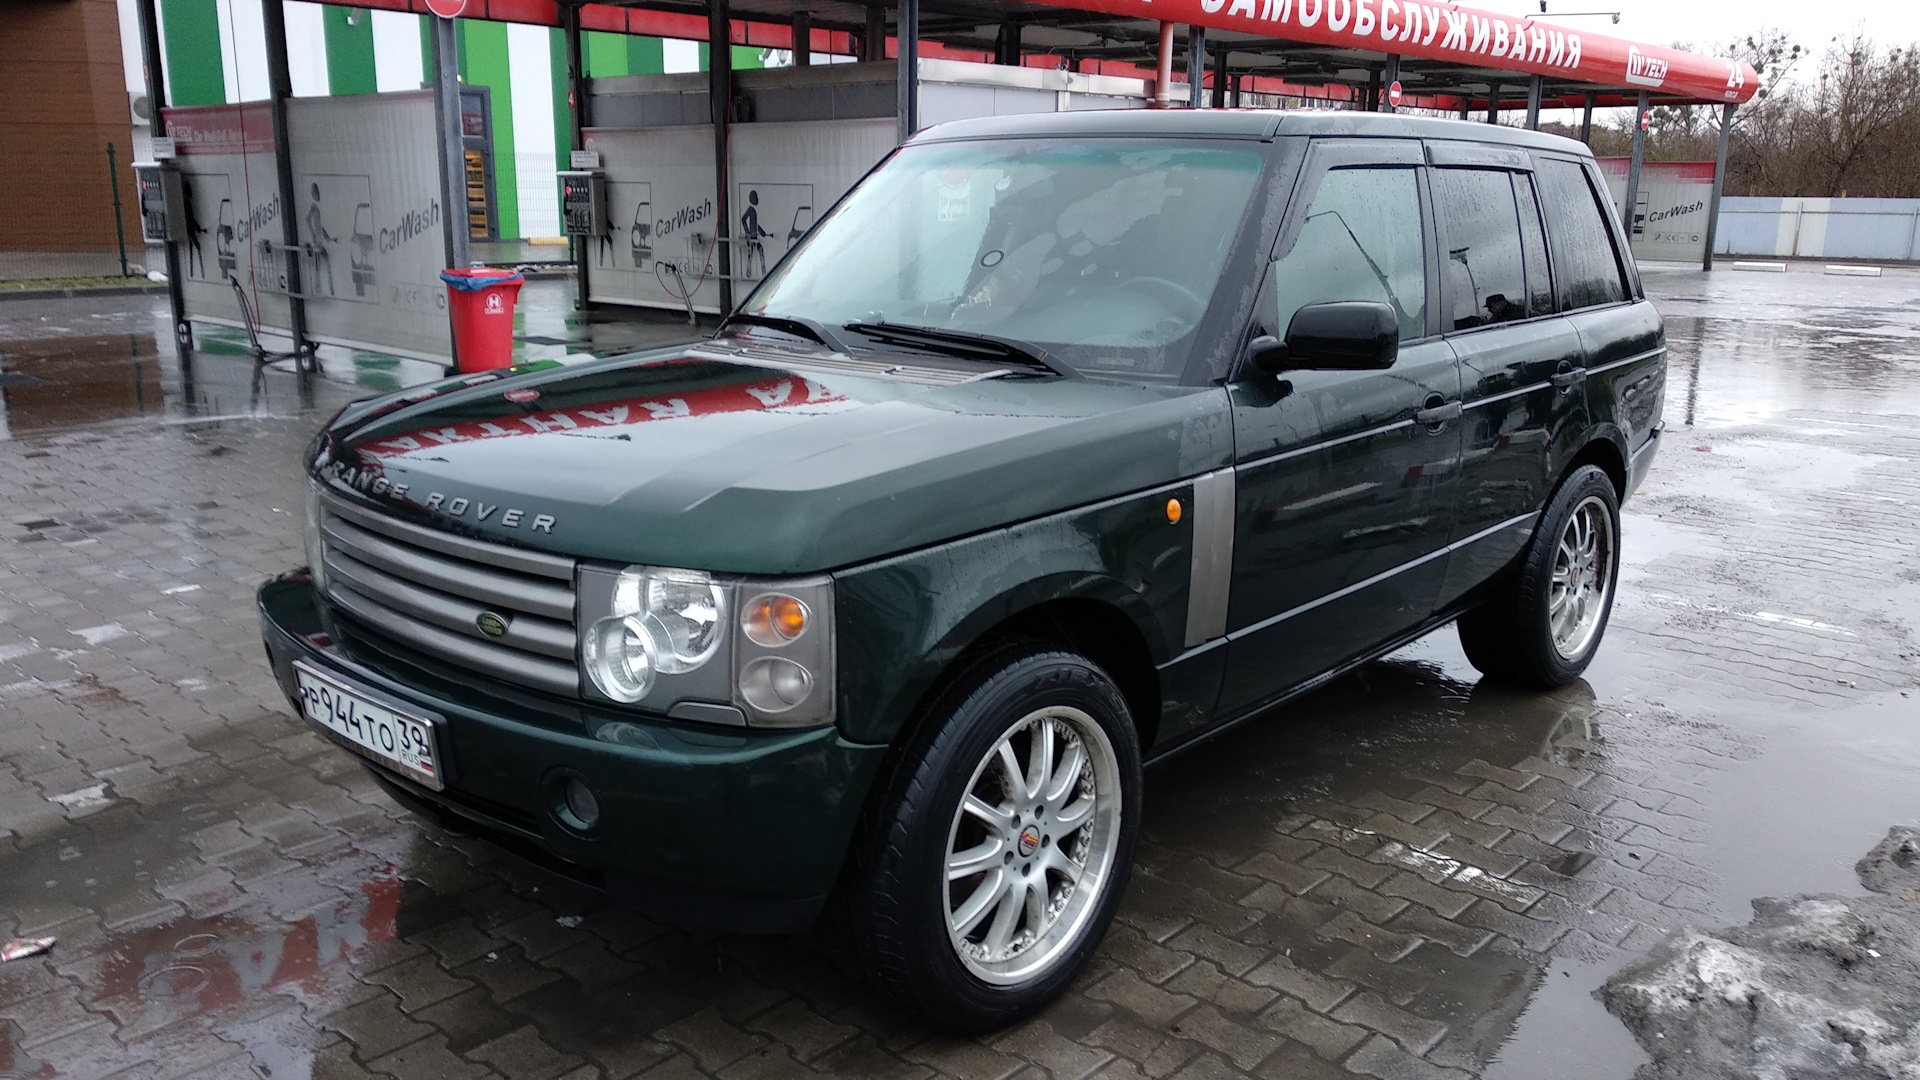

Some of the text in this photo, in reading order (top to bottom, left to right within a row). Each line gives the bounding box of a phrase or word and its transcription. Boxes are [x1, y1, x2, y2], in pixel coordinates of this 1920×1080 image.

[1200, 0, 1581, 69] МООБСЛУЖИВАНИЯ
[1725, 61, 1744, 88] 24
[568, 92, 575, 105] 4
[379, 197, 439, 255] CarWash
[655, 197, 711, 238] CarWash
[1649, 200, 1703, 223] CarWash
[329, 459, 557, 535] RANGE ROVER
[396, 718, 429, 756] 39
[400, 748, 421, 767] RUS
